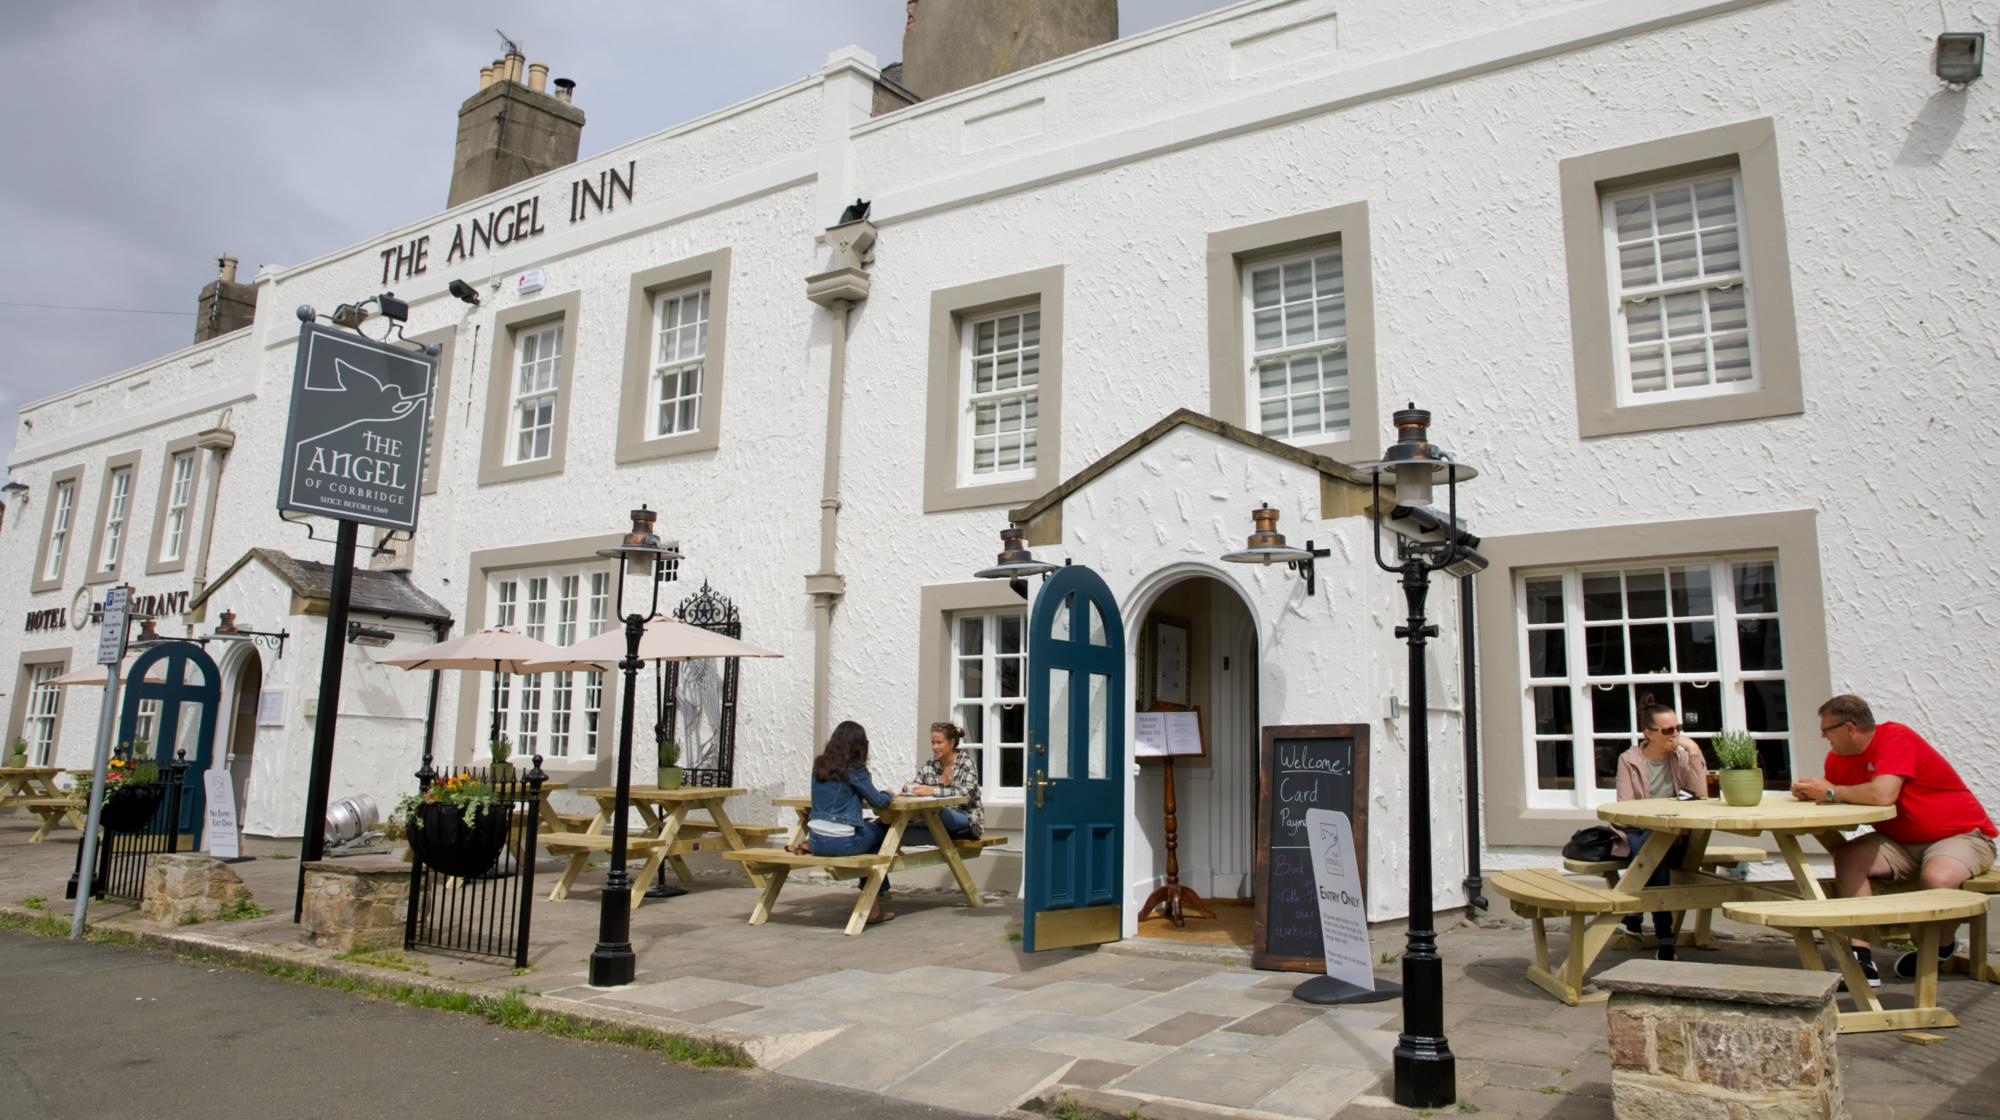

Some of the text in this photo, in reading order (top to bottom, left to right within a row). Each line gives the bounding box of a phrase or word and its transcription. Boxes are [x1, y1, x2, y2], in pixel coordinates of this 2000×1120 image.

[380, 160, 636, 285] THE ANGEL INN
[362, 430, 403, 458] THE
[306, 446, 406, 490] ANGEL
[305, 477, 405, 505] OF CORBRIDGE
[319, 495, 342, 506] SINCE
[343, 500, 373, 512] BEFORE
[25, 607, 67, 632] HOTEL
[1280, 745, 1351, 775] Welcome!
[1280, 777, 1319, 803] Card
